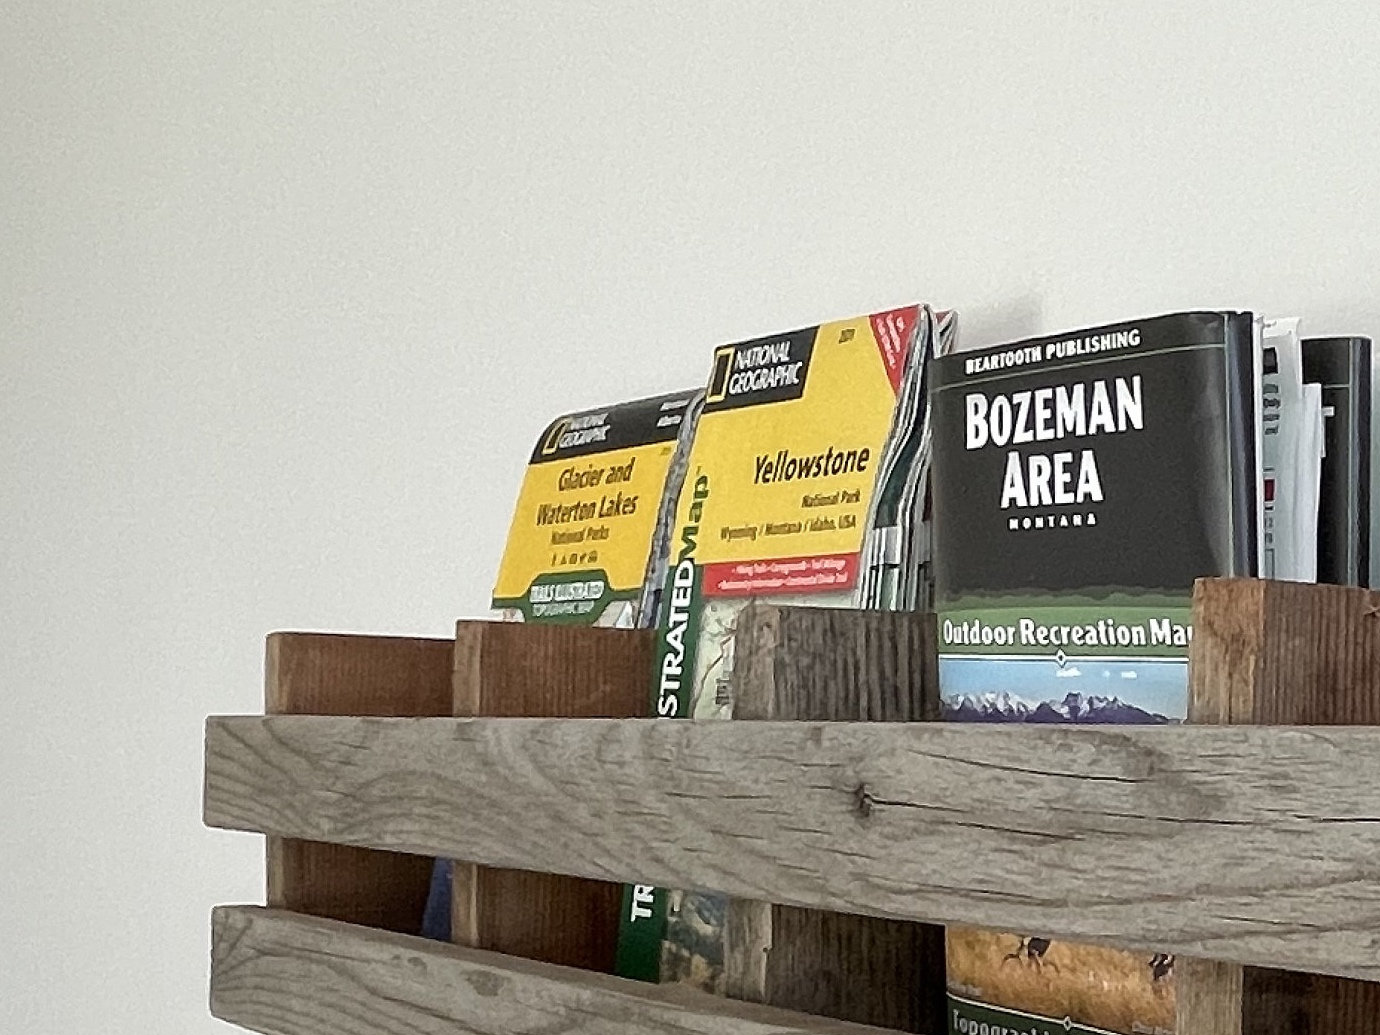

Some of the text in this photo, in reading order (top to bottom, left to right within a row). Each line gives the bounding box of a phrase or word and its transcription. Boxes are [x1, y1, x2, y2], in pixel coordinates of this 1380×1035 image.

[734, 341, 791, 369] NATIONAL
[965, 328, 1141, 375] BEARTOOTH PUBLISHING
[728, 361, 803, 394] GEOGRAPHIC
[964, 374, 1145, 451] BOZEMAN
[558, 456, 636, 492] Glacier and
[754, 446, 870, 485] Yellowstone
[1000, 449, 1104, 510] AREA
[536, 491, 639, 526] Waterton Lakes
[1008, 513, 1097, 530] MONTANA
[657, 559, 694, 719] STRATED
[943, 618, 1016, 645] Outdoor
[1019, 617, 1147, 646] Recreation
